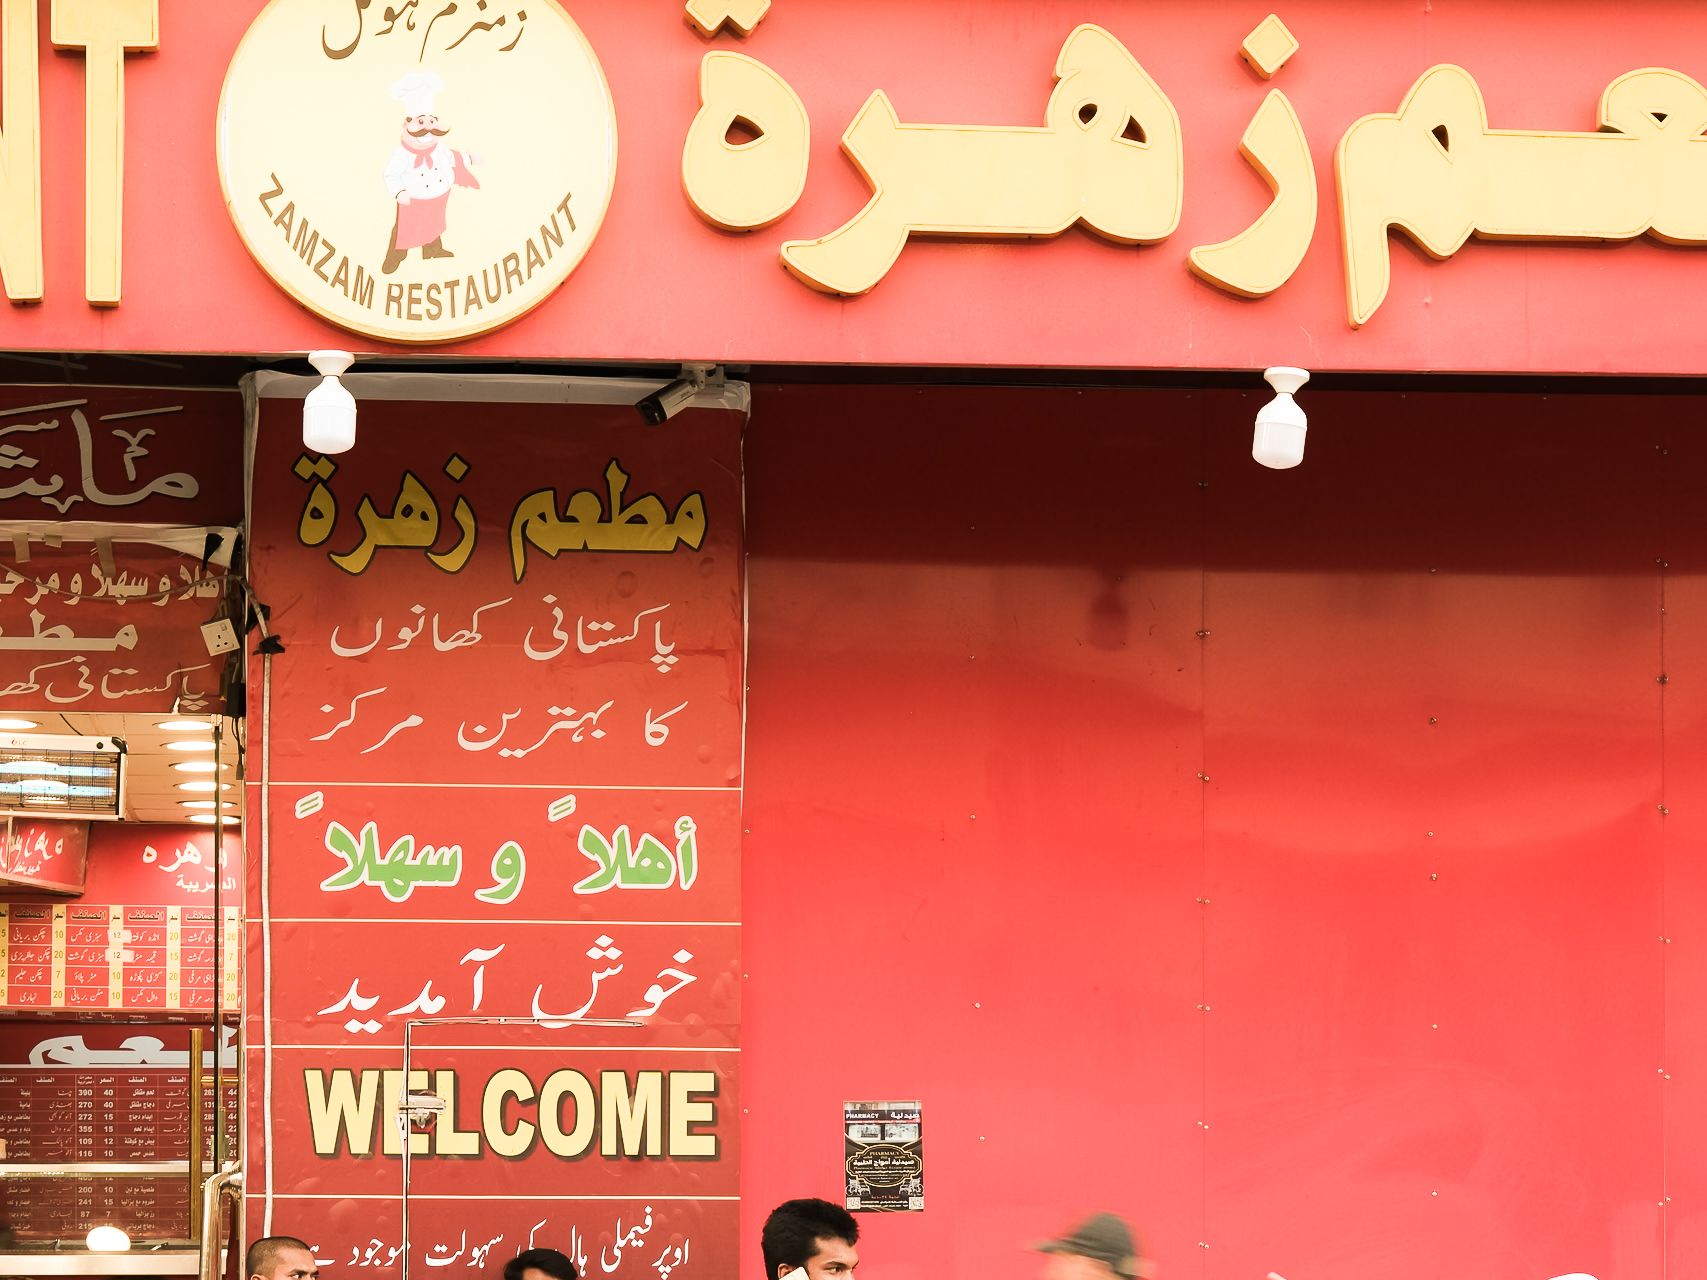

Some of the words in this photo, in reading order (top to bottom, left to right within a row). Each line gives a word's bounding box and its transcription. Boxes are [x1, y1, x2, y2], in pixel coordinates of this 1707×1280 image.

[258, 172, 376, 310] ZAMZAM
[385, 192, 578, 321] RESTAURANT
[292, 455, 477, 575] زهرة
[509, 457, 708, 583] مطعم
[330, 597, 513, 657] کھانوں
[523, 593, 680, 673] پاکستانی
[309, 686, 424, 754] مرکز
[457, 700, 614, 758] بہترین
[644, 701, 688, 746] کا
[474, 840, 526, 904] و
[54, 950, 64, 959] 20
[316, 943, 506, 1034] آمدید
[531, 934, 699, 1029] خوش
[54, 990, 63, 999] 20
[78, 1089, 93, 1097] 390
[78, 1101, 93, 1109] 270
[103, 1089, 114, 1097] 40
[103, 1101, 114, 1109] 40
[78, 1113, 93, 1121] 272
[103, 1113, 114, 1121] 15
[304, 1069, 720, 1160] WELCOME
[103, 1125, 114, 1133] 15
[103, 1138, 114, 1146] 12
[103, 1150, 114, 1158] 10
[103, 1186, 114, 1194] 10
[103, 1198, 114, 1206] 15
[80, 1210, 90, 1218] 87
[106, 1210, 112, 1218] 7
[424, 1229, 504, 1269] سہولت
[600, 1204, 654, 1273] فیملی
[651, 1237, 690, 1280] اوپر
